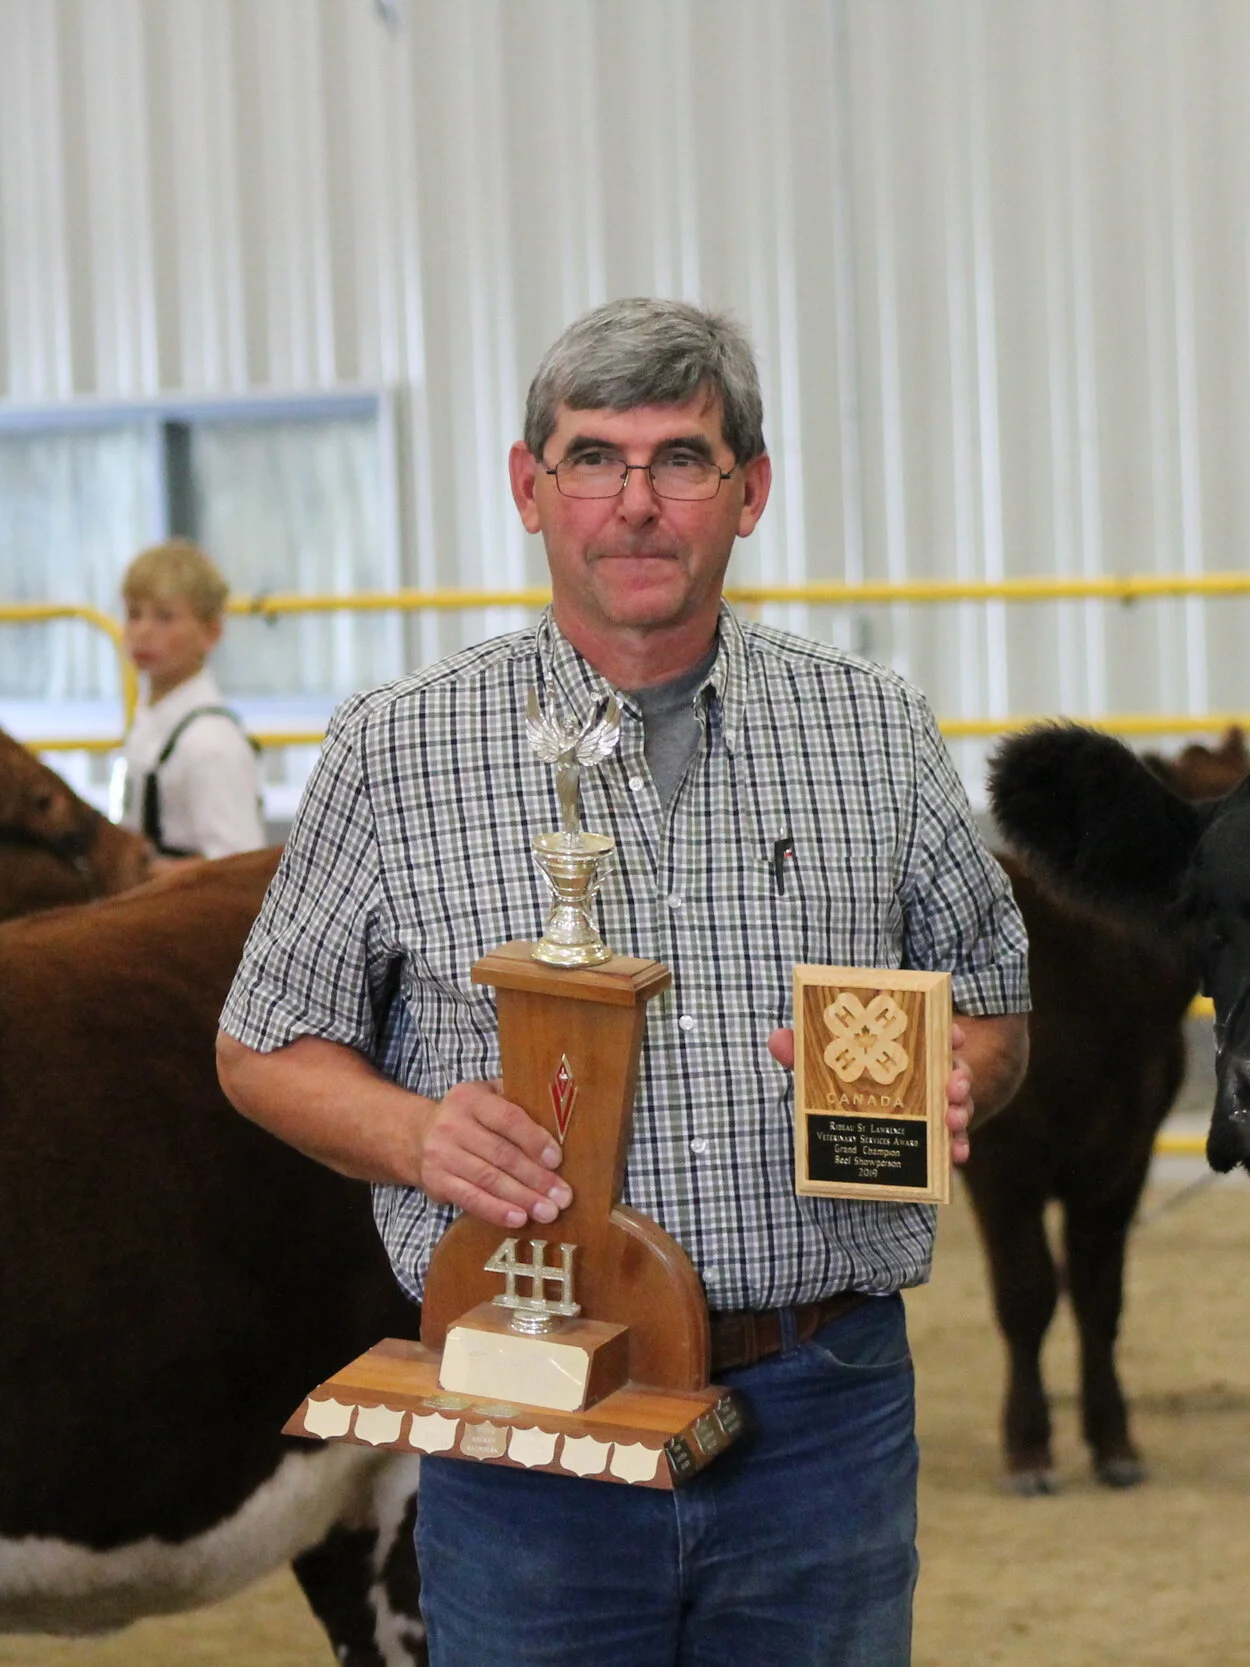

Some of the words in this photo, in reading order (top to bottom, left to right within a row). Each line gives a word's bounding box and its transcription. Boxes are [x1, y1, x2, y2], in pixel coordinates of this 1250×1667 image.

[826, 1092, 905, 1108] CANADA
[834, 1144, 857, 1154] Grand
[862, 1146, 901, 1158] Champion
[834, 1155, 851, 1165] Beef
[854, 1156, 902, 1168] Showperson
[858, 1168, 878, 1177] 2019
